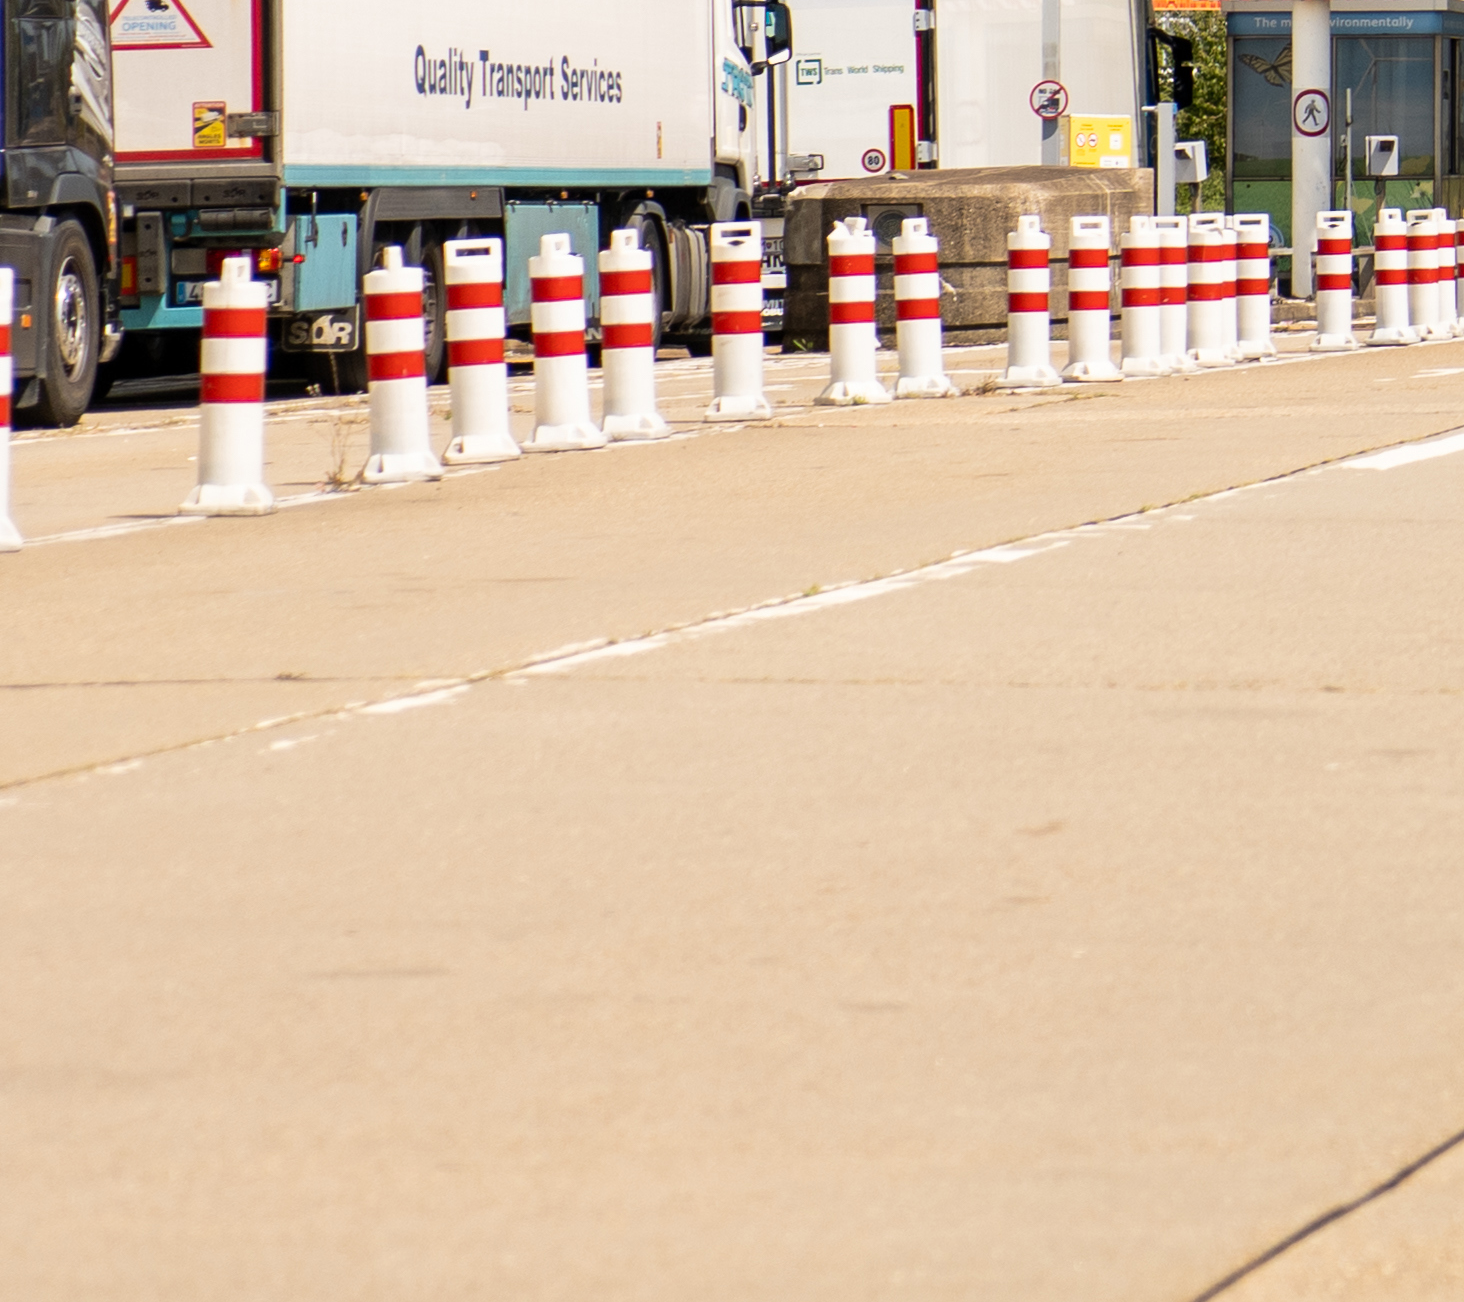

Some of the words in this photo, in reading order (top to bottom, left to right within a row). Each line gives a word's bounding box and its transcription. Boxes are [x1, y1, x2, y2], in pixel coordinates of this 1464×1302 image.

[122, 21, 176, 32] OPENING
[1254, 16, 1278, 28] The
[800, 68, 818, 77] TWS
[824, 67, 843, 75] Trans
[847, 65, 869, 74] World
[872, 63, 905, 74] Shipping
[414, 44, 475, 110] Quality
[478, 49, 555, 111] Transport
[561, 55, 623, 104] Services
[867, 155, 880, 166] 80
